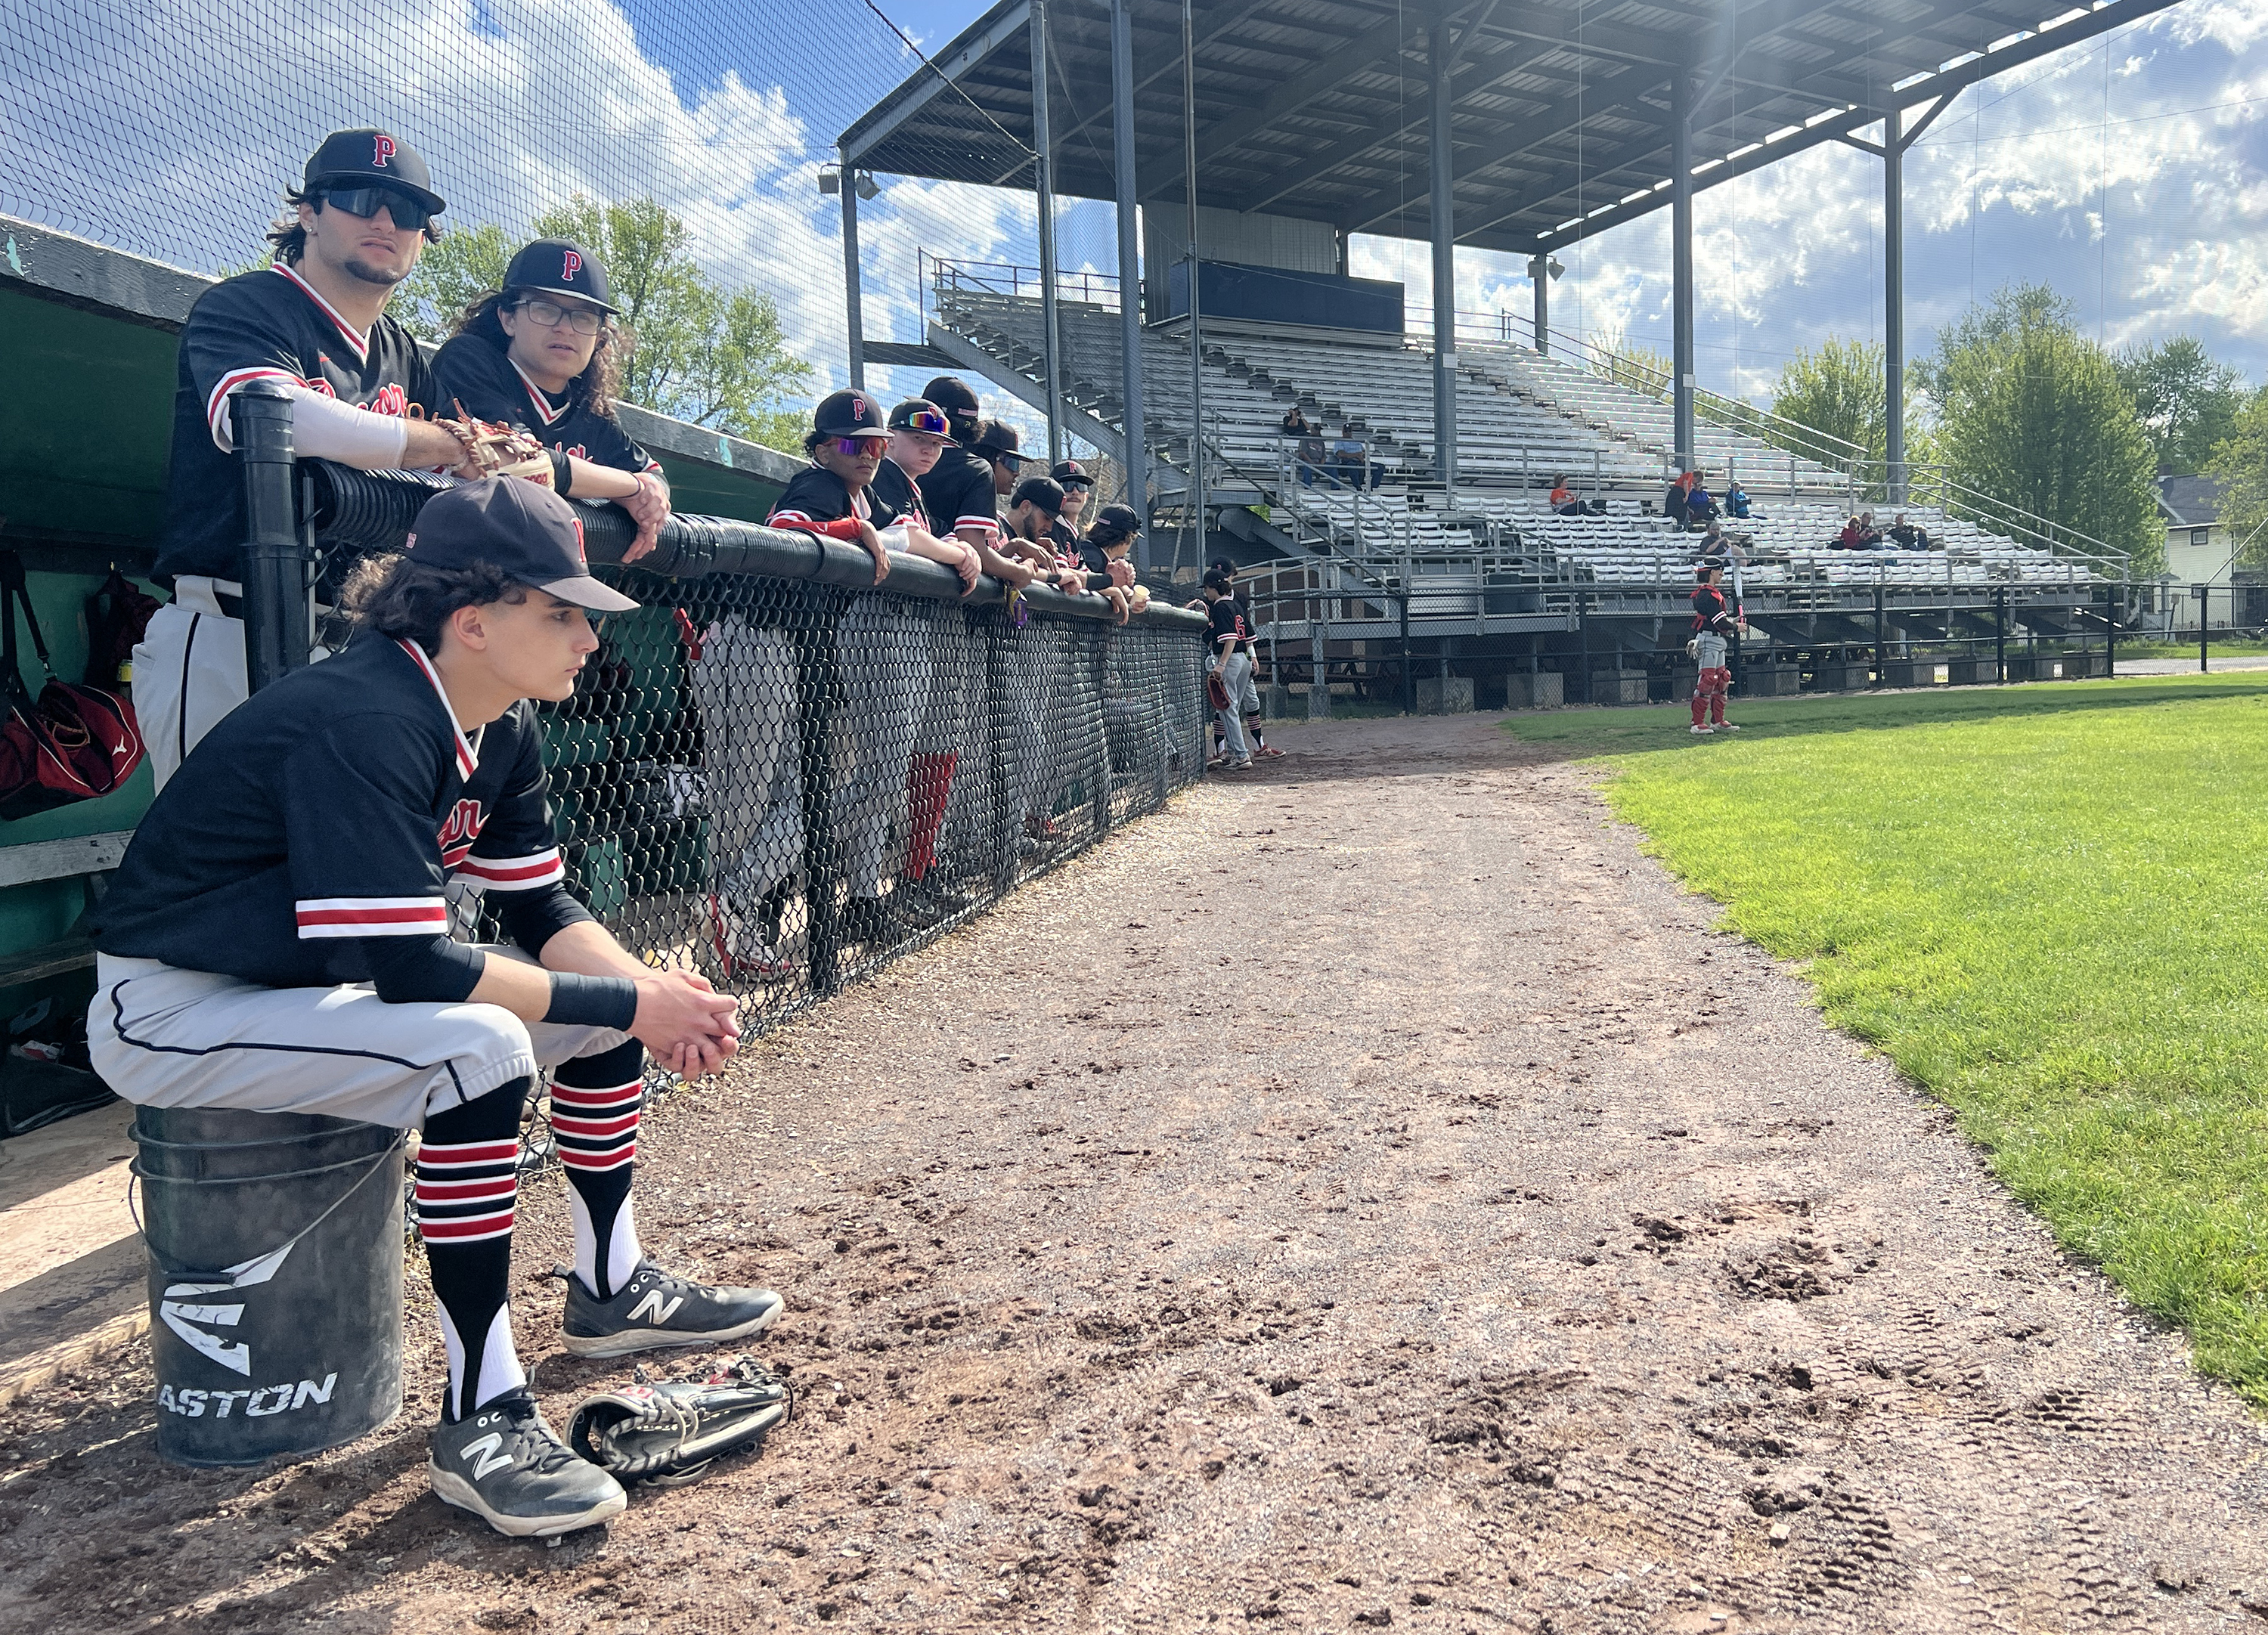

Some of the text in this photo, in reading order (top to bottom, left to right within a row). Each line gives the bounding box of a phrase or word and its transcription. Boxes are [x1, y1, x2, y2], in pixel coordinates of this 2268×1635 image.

[372, 135, 397, 167] P
[562, 250, 582, 281] P
[853, 398, 866, 421] P
[1235, 615, 1247, 641] 6
[158, 1371, 338, 1419] ASTON
